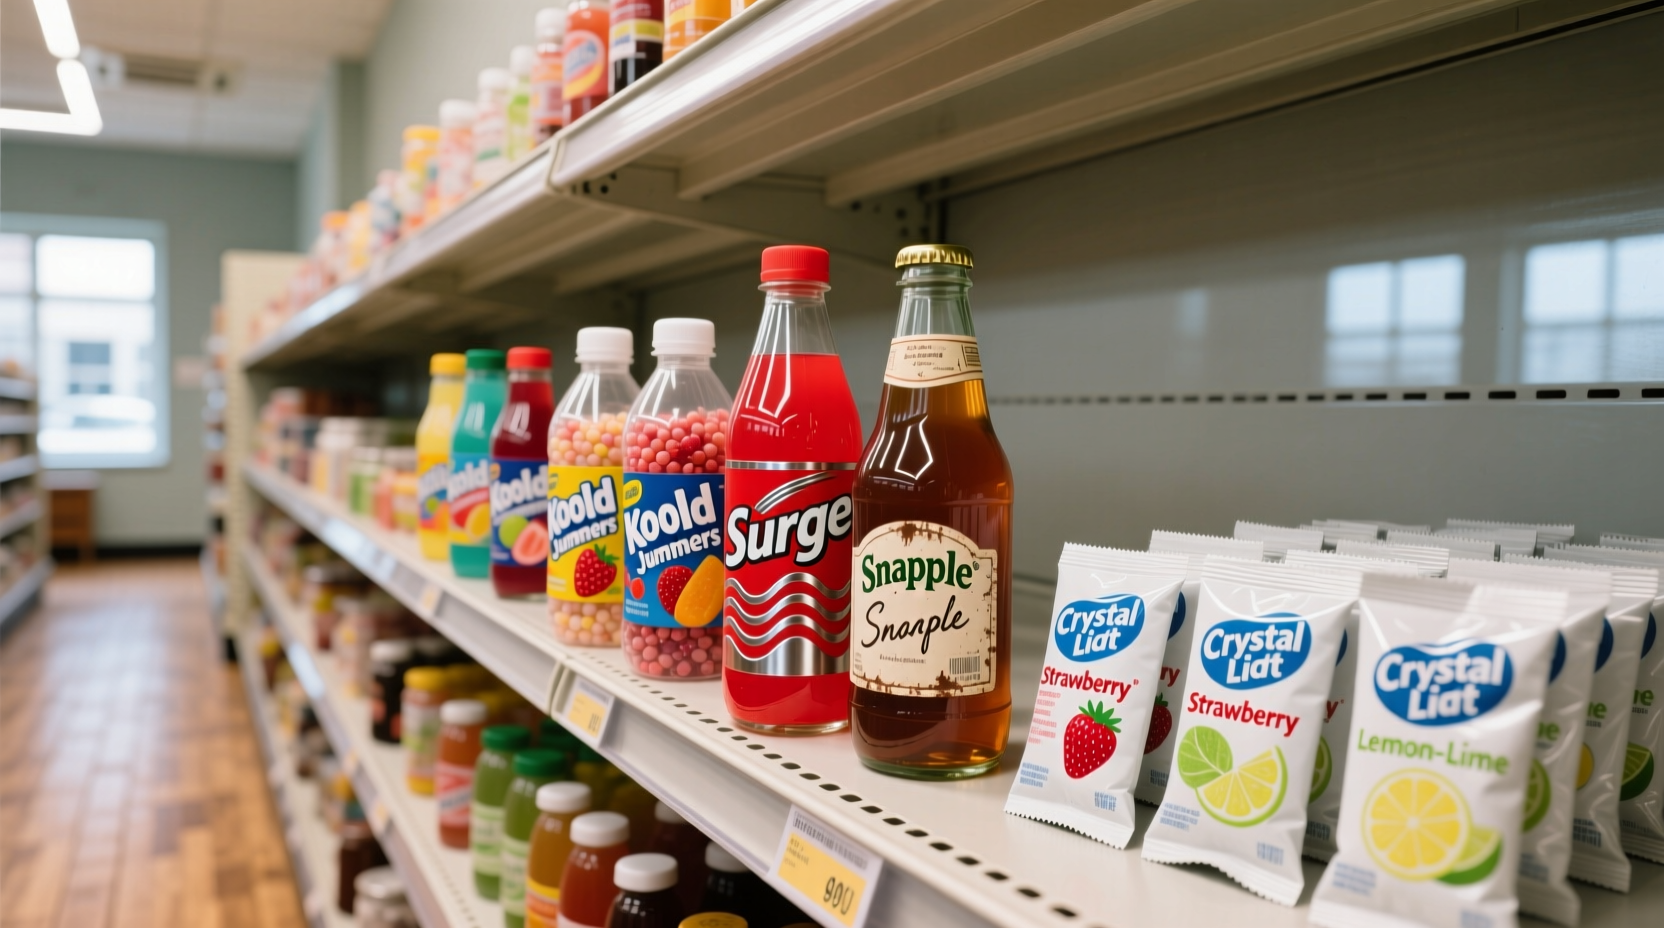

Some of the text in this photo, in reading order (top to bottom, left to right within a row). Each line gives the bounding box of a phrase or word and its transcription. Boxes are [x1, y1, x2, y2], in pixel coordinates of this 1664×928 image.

[547, 476, 617, 541] Koold
[623, 482, 717, 556] Koold
[725, 495, 852, 568] Surge
[636, 527, 721, 575] Jummers
[861, 550, 973, 593] Snapple
[1056, 598, 1141, 636] Crystal
[1203, 620, 1306, 660] Crystal
[1040, 666, 1132, 703] Strawberry
[1375, 645, 1506, 692] Crystal
[1187, 691, 1300, 738] Strawberry
[1357, 728, 1510, 775] Lemon-Lime
